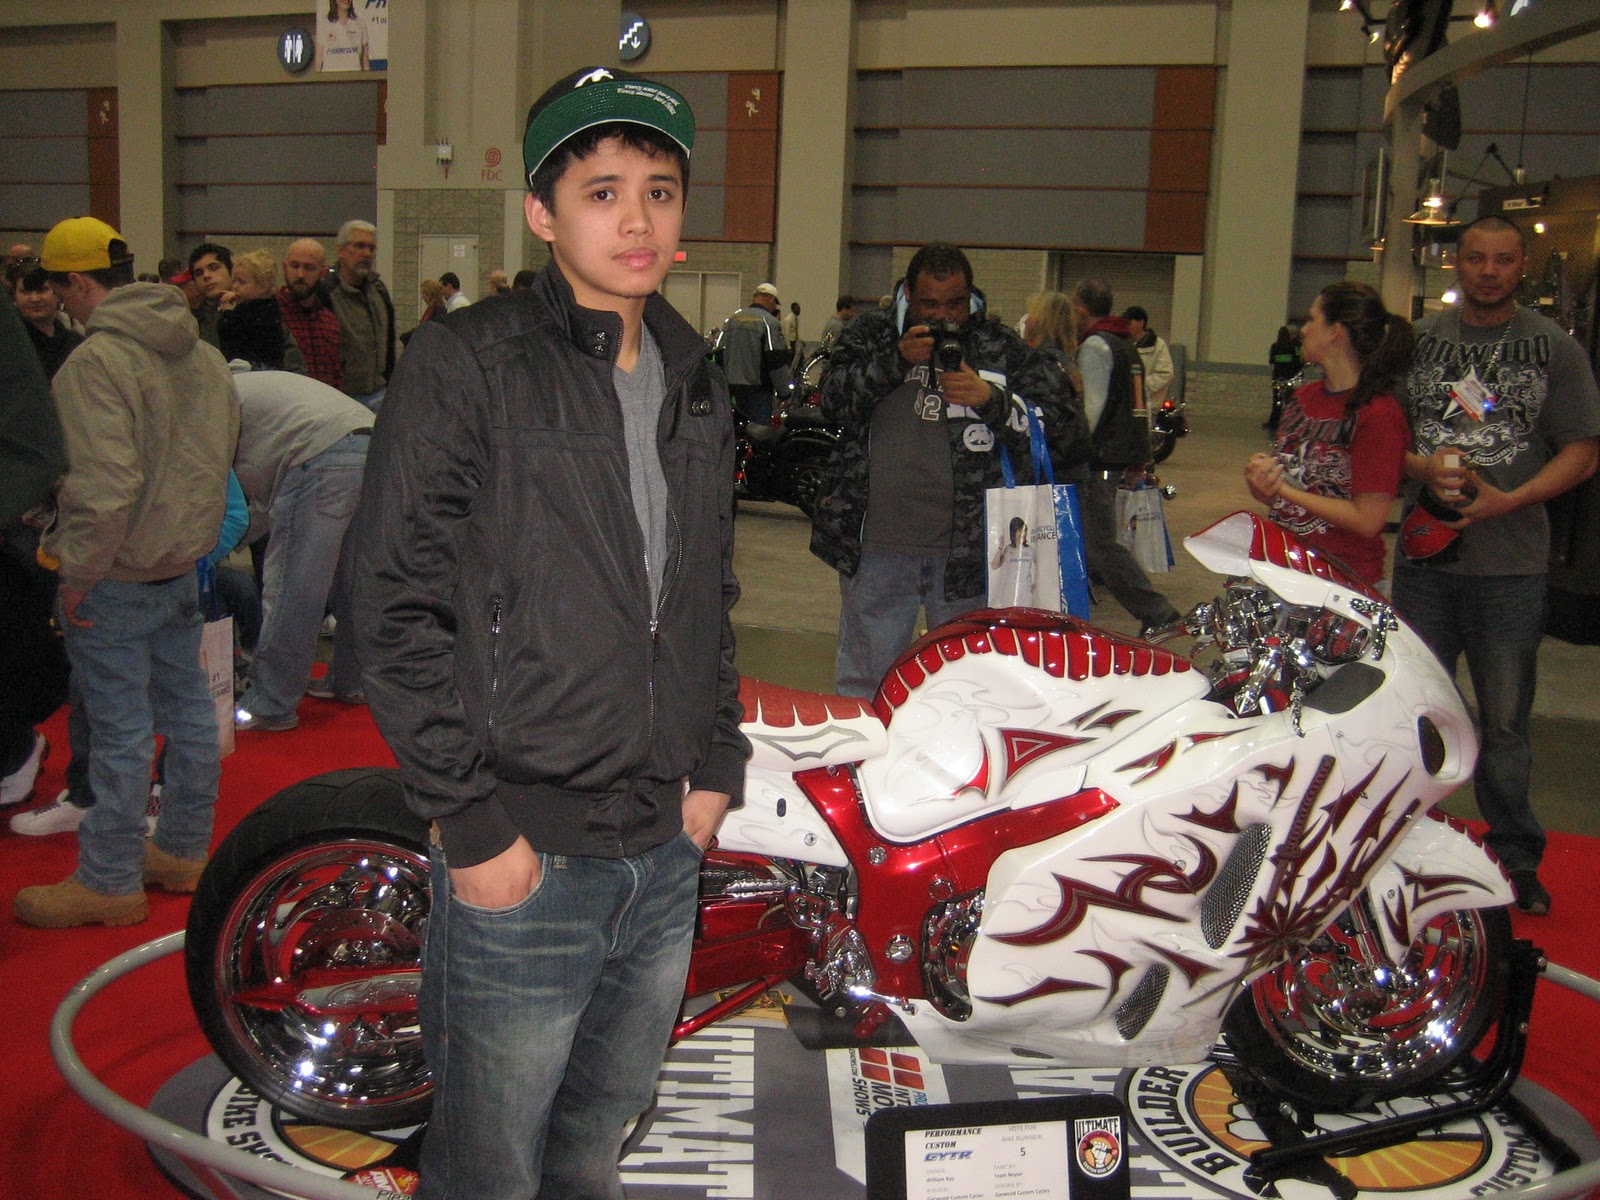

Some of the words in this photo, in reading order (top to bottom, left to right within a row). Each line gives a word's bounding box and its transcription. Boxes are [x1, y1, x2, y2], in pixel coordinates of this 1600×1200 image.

[481, 170, 503, 181] FDC
[1407, 382, 1453, 397] CUSTO
[852, 1079, 871, 1117] SHOWS
[894, 1086, 912, 1107] INT
[1136, 1065, 1241, 1176] BUILDER
[923, 1127, 982, 1139] PERFORMANCE
[1075, 1118, 1120, 1142] ULTIMATE
[1001, 1135, 1015, 1143] BIKE
[924, 1141, 957, 1150] CUSTOM
[923, 1150, 974, 1162] GYTR
[1019, 1147, 1026, 1157] 5
